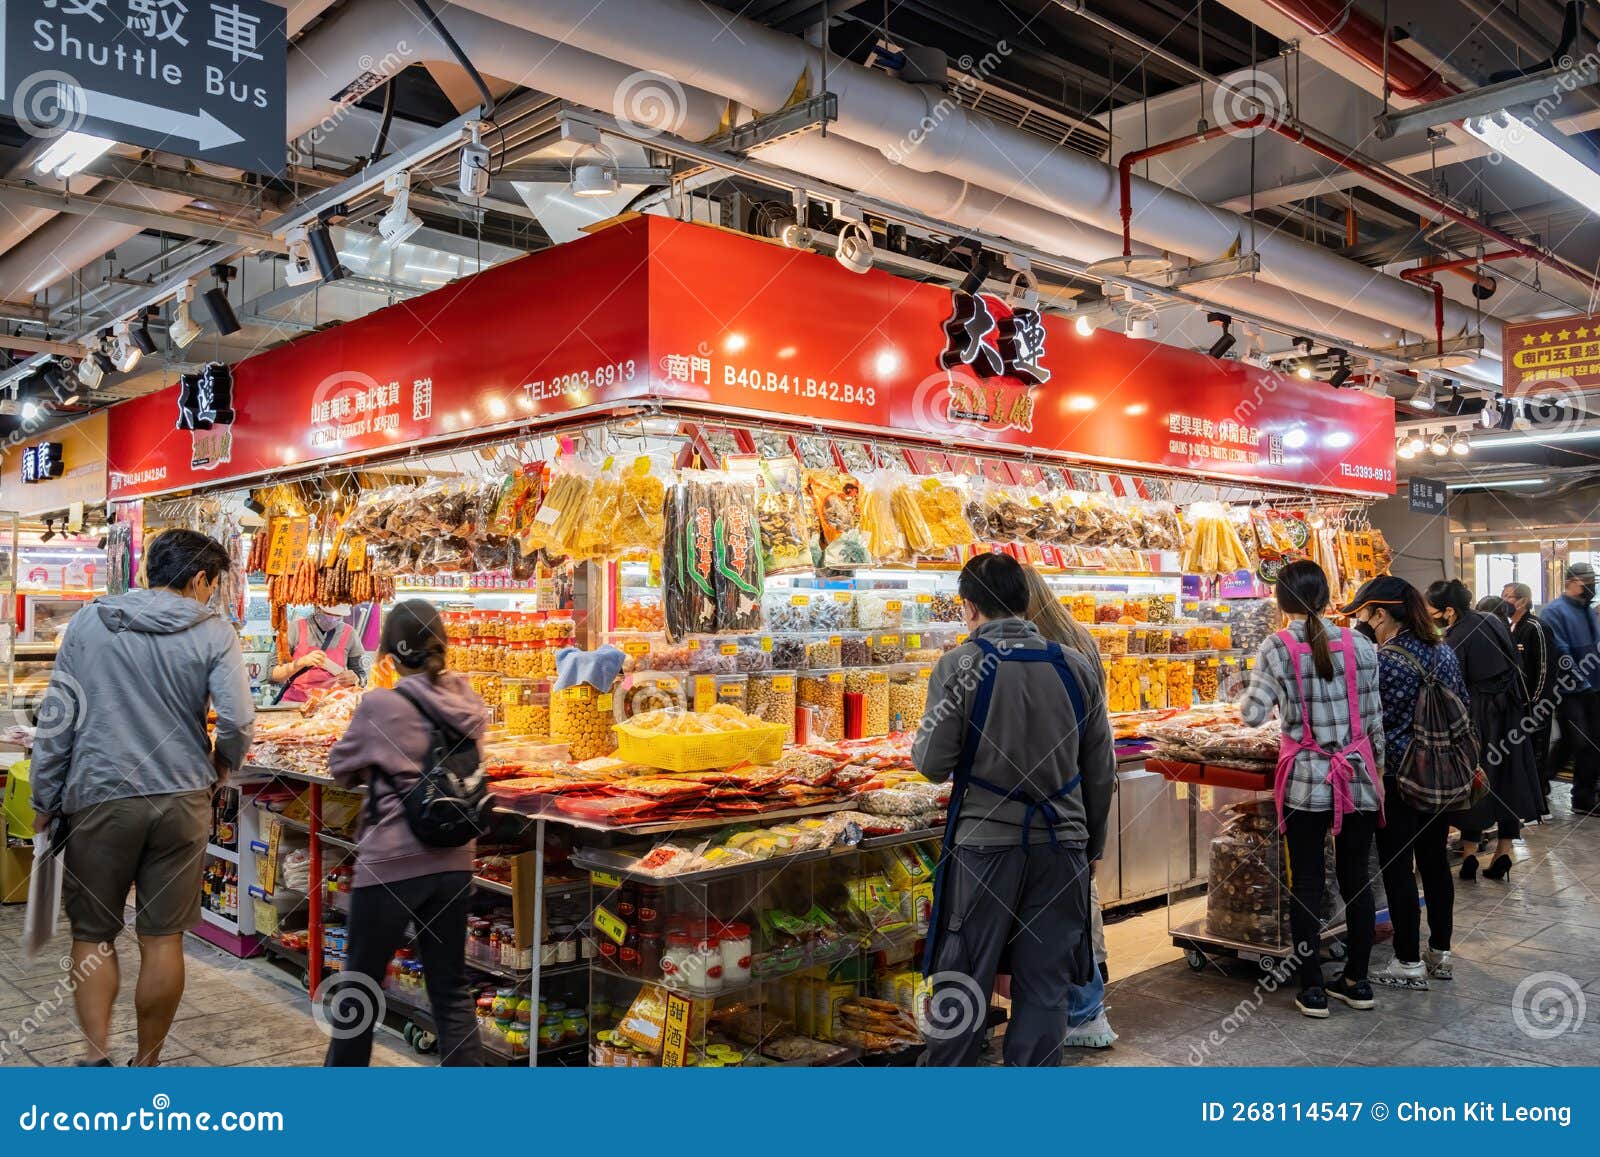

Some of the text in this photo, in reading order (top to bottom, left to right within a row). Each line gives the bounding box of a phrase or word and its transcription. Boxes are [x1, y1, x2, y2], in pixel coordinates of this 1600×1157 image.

[32, 19, 268, 108] Shuttle Bus
[355, 382, 400, 413] 南北乾貨
[523, 359, 636, 402] TEL:3393-6913
[667, 354, 876, 407] 南門 B40.B41.B42.B43
[1340, 463, 1392, 481] TEL:3393-6913
